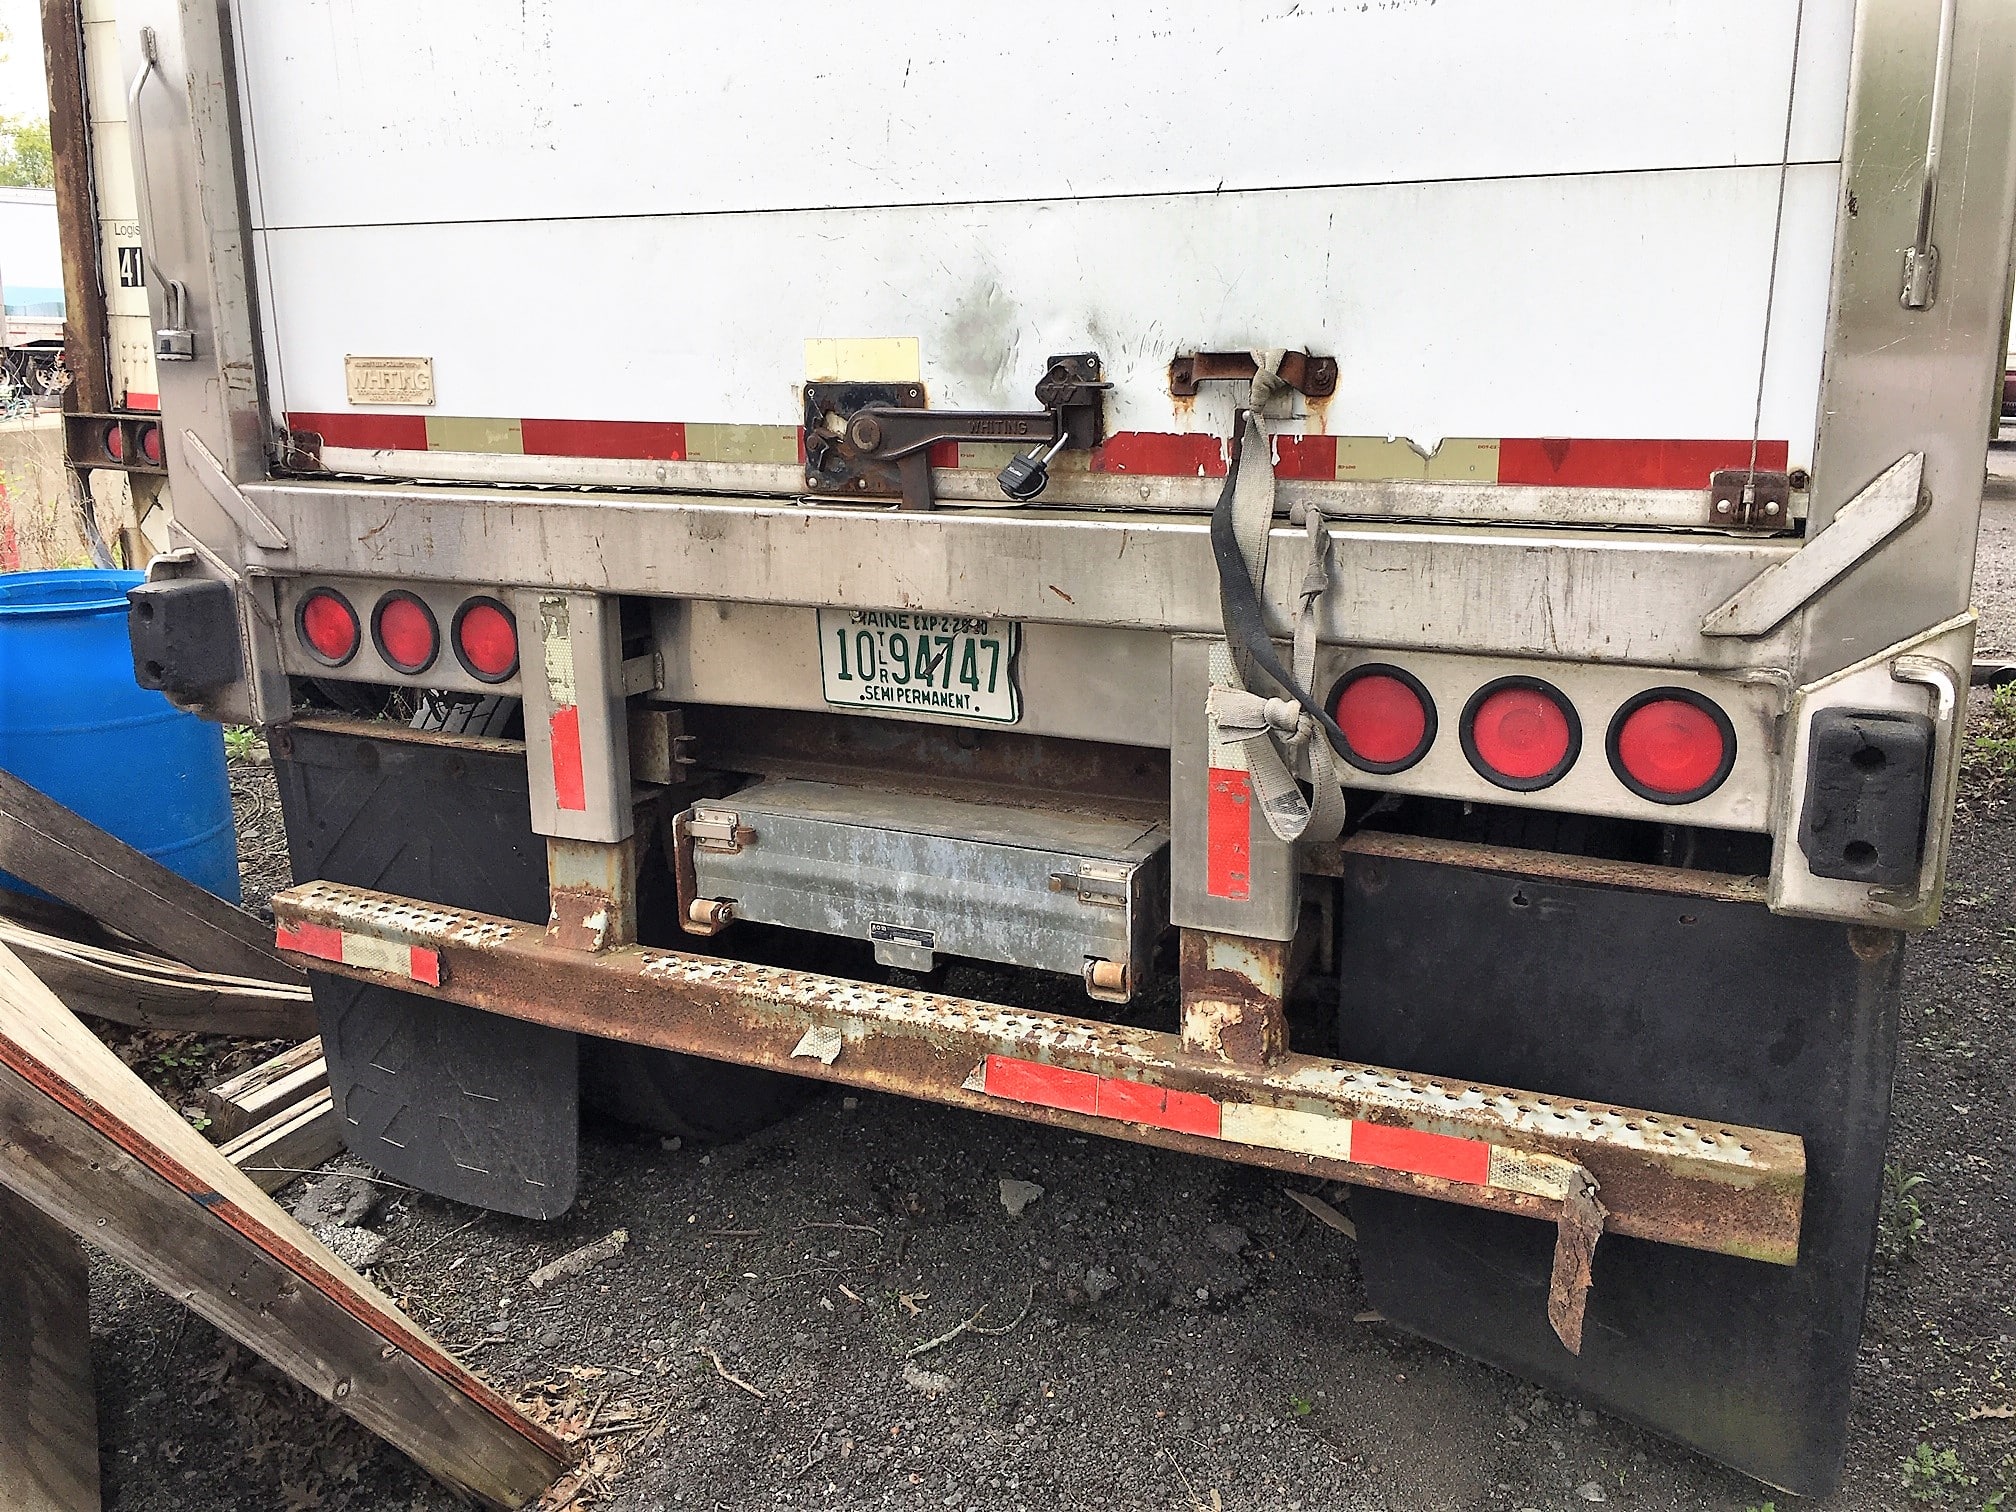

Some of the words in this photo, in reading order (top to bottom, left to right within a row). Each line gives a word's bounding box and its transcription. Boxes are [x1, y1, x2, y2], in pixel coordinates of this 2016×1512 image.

[967, 420, 1028, 435] WHITING
[837, 628, 875, 681] 10
[889, 632, 1000, 693] 94747
[864, 685, 894, 701] SEMI
[897, 688, 970, 710] PERMANENT
